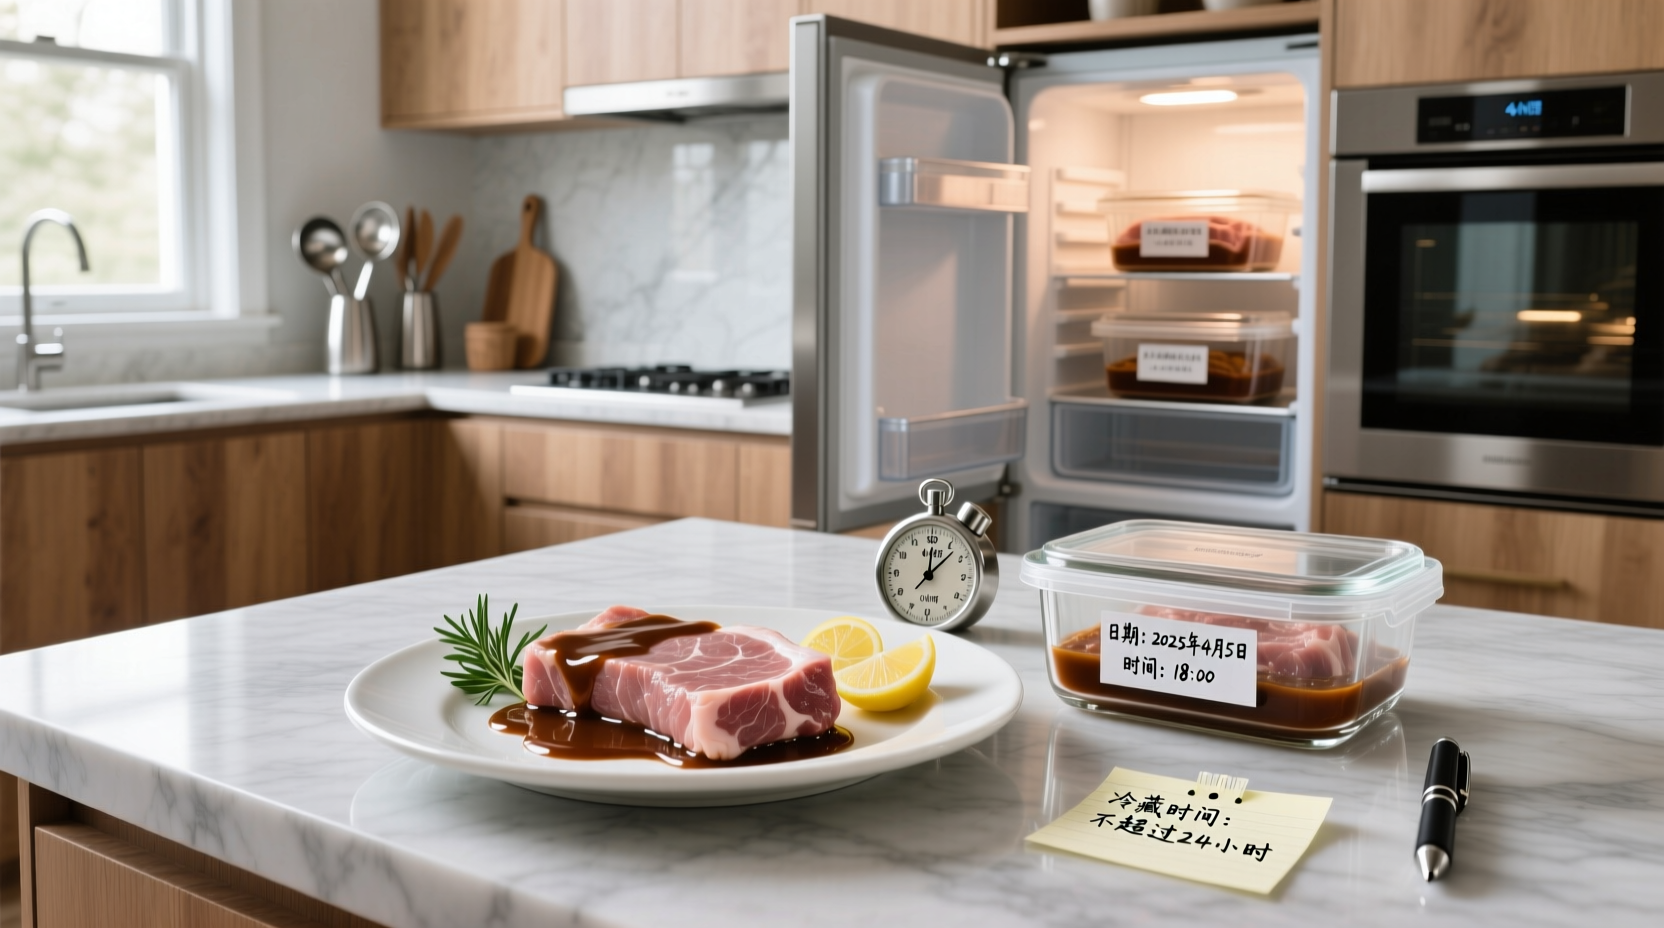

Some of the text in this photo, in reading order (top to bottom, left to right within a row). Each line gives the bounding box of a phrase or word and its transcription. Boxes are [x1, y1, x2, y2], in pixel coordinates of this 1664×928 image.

[1108, 791, 1231, 828] 冷藏时间：
[1090, 813, 1273, 862] 不超过24小时
